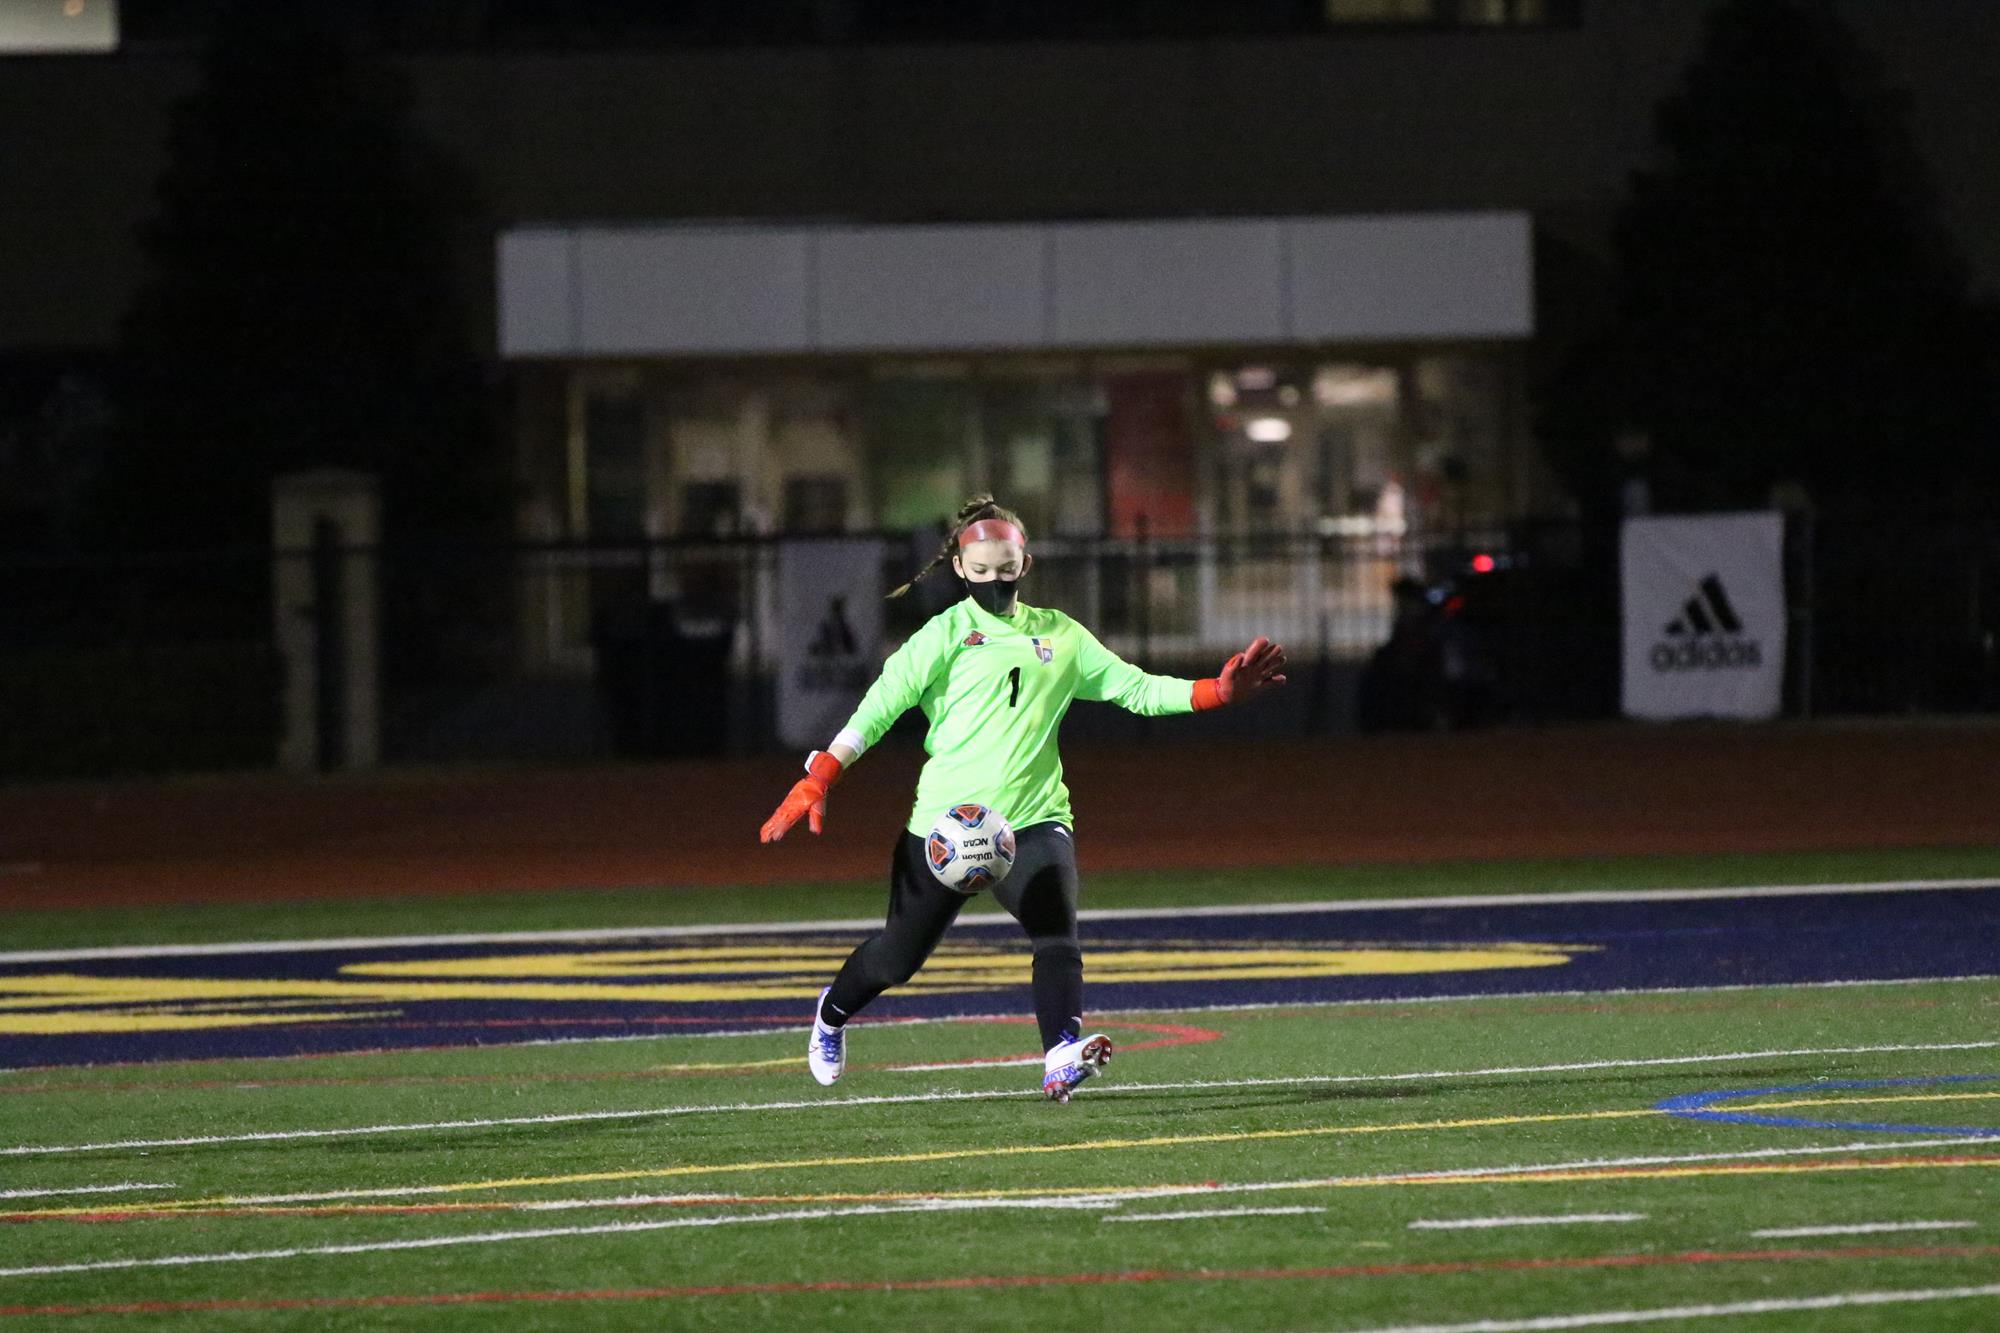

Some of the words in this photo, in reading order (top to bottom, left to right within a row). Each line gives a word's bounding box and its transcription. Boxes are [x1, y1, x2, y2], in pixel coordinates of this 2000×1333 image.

[1008, 666, 1021, 708] 1
[962, 837, 989, 848] NCAA
[962, 851, 993, 862] Wilson
